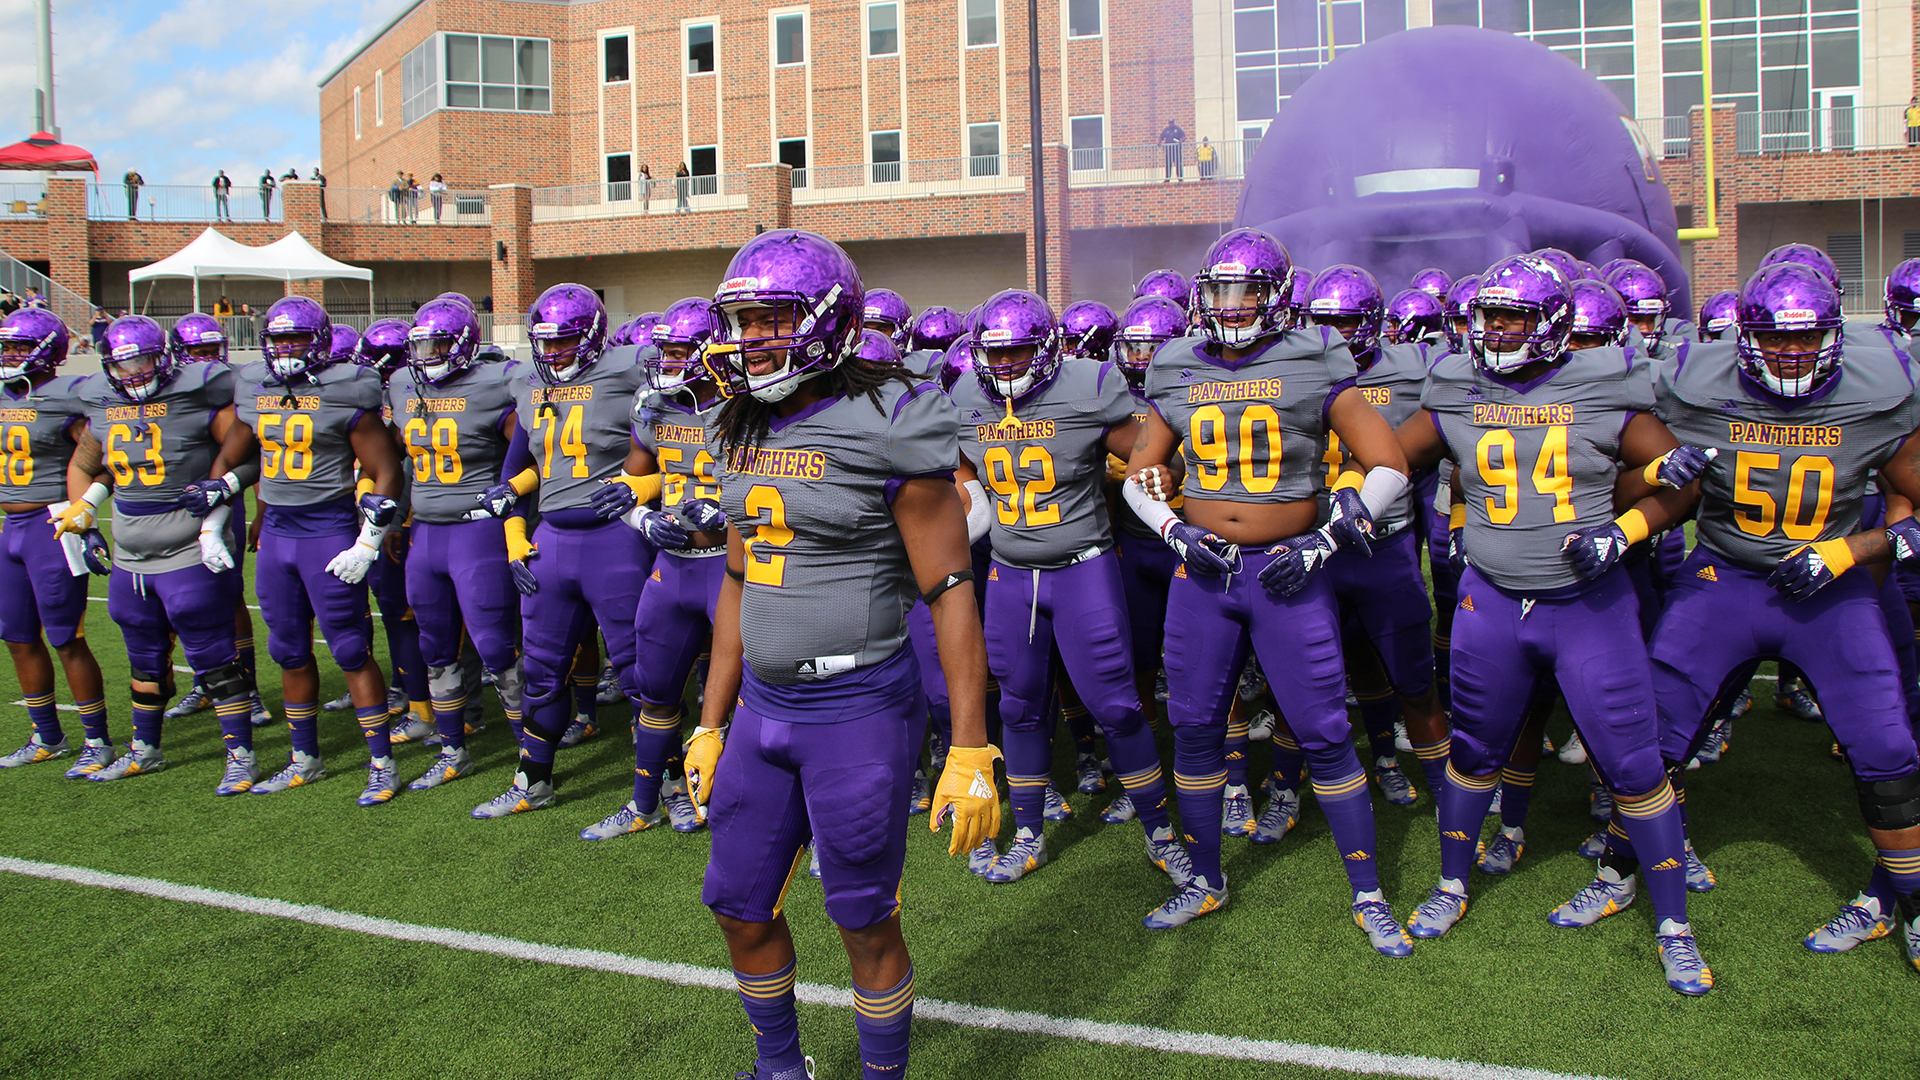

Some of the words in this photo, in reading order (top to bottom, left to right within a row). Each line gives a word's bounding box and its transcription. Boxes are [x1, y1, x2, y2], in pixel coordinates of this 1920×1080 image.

[255, 396, 320, 411] PANERS
[1188, 379, 1282, 403] PANTHERS
[1474, 404, 1574, 426] PANTHERS
[106, 422, 167, 487] 63
[256, 413, 314, 481] 58
[404, 417, 464, 485] 68
[532, 405, 590, 480] 74
[976, 420, 1056, 443] PANTHERS
[1189, 404, 1284, 495] 90
[1729, 422, 1842, 447] PANTHERS
[983, 446, 1062, 528] 92
[1475, 425, 1578, 526] 94
[1733, 450, 1836, 541] 50
[743, 483, 795, 588] 2
[823, 661, 830, 671] L
